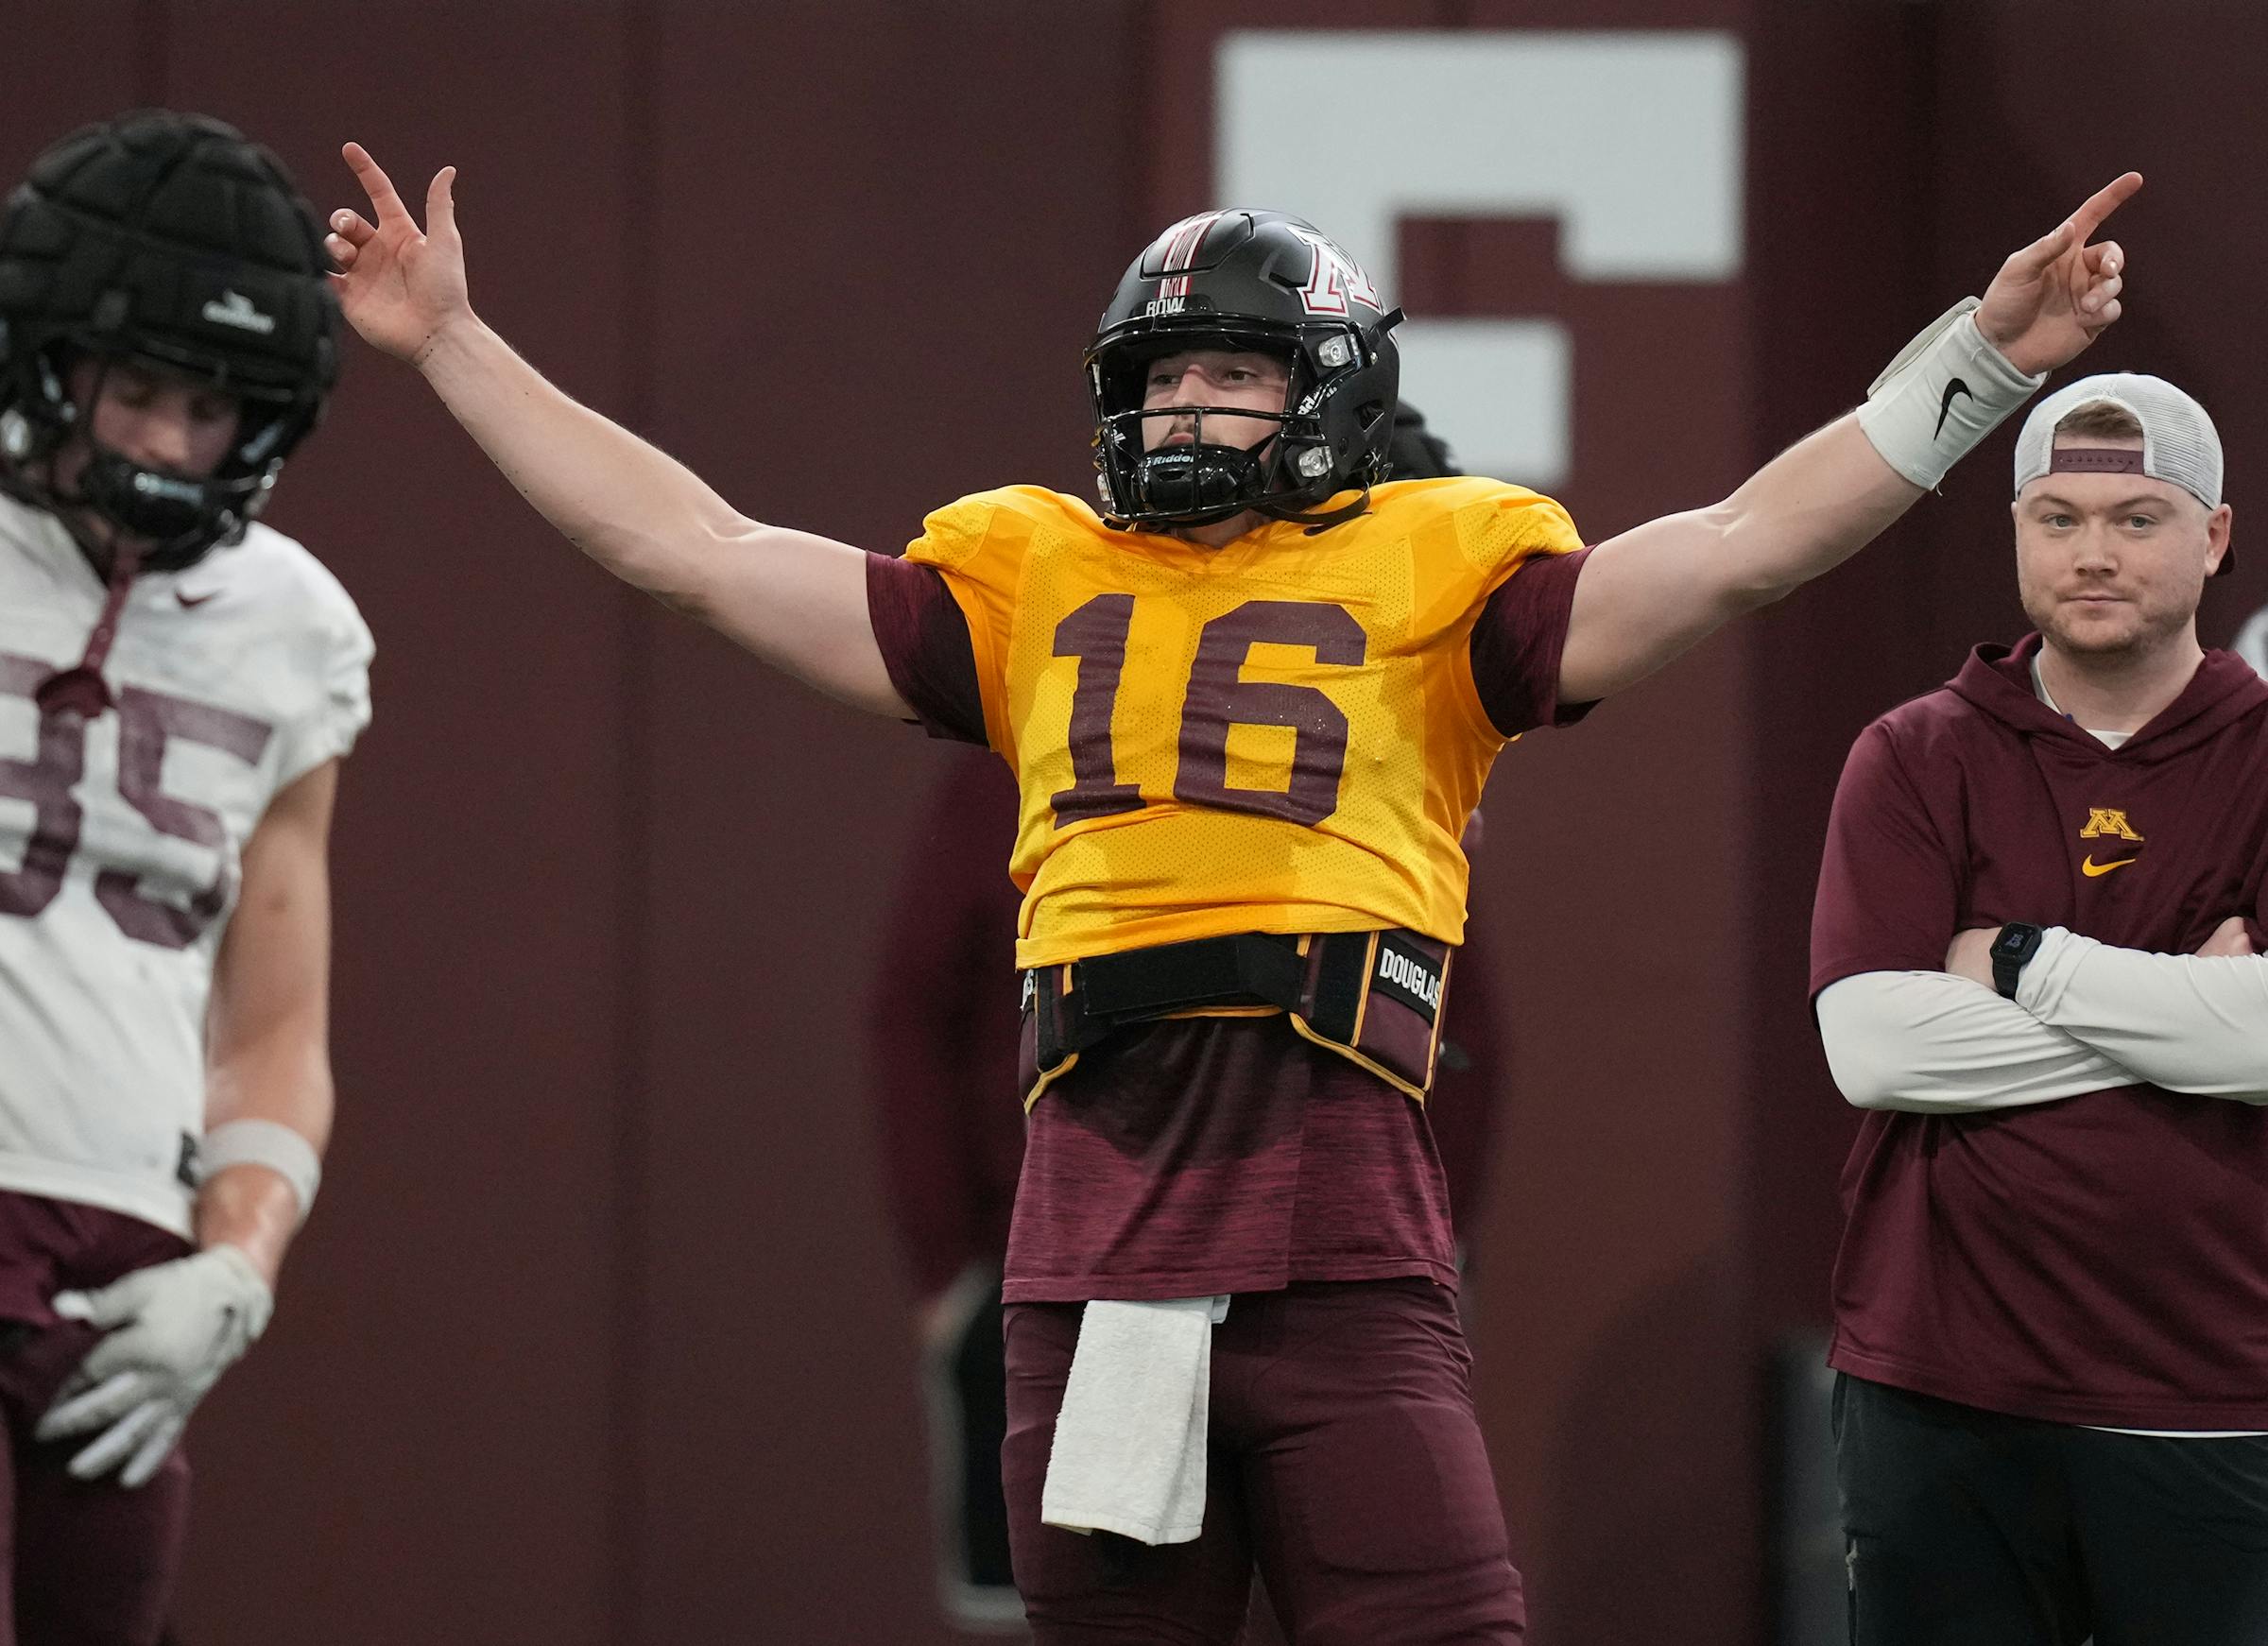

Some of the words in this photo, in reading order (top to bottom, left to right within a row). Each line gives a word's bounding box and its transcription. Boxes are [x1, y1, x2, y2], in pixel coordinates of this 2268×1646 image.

[1152, 454, 1194, 466] Riddel
[1050, 592, 1367, 831] 16
[1379, 948, 1440, 1010] DOUGLAS
